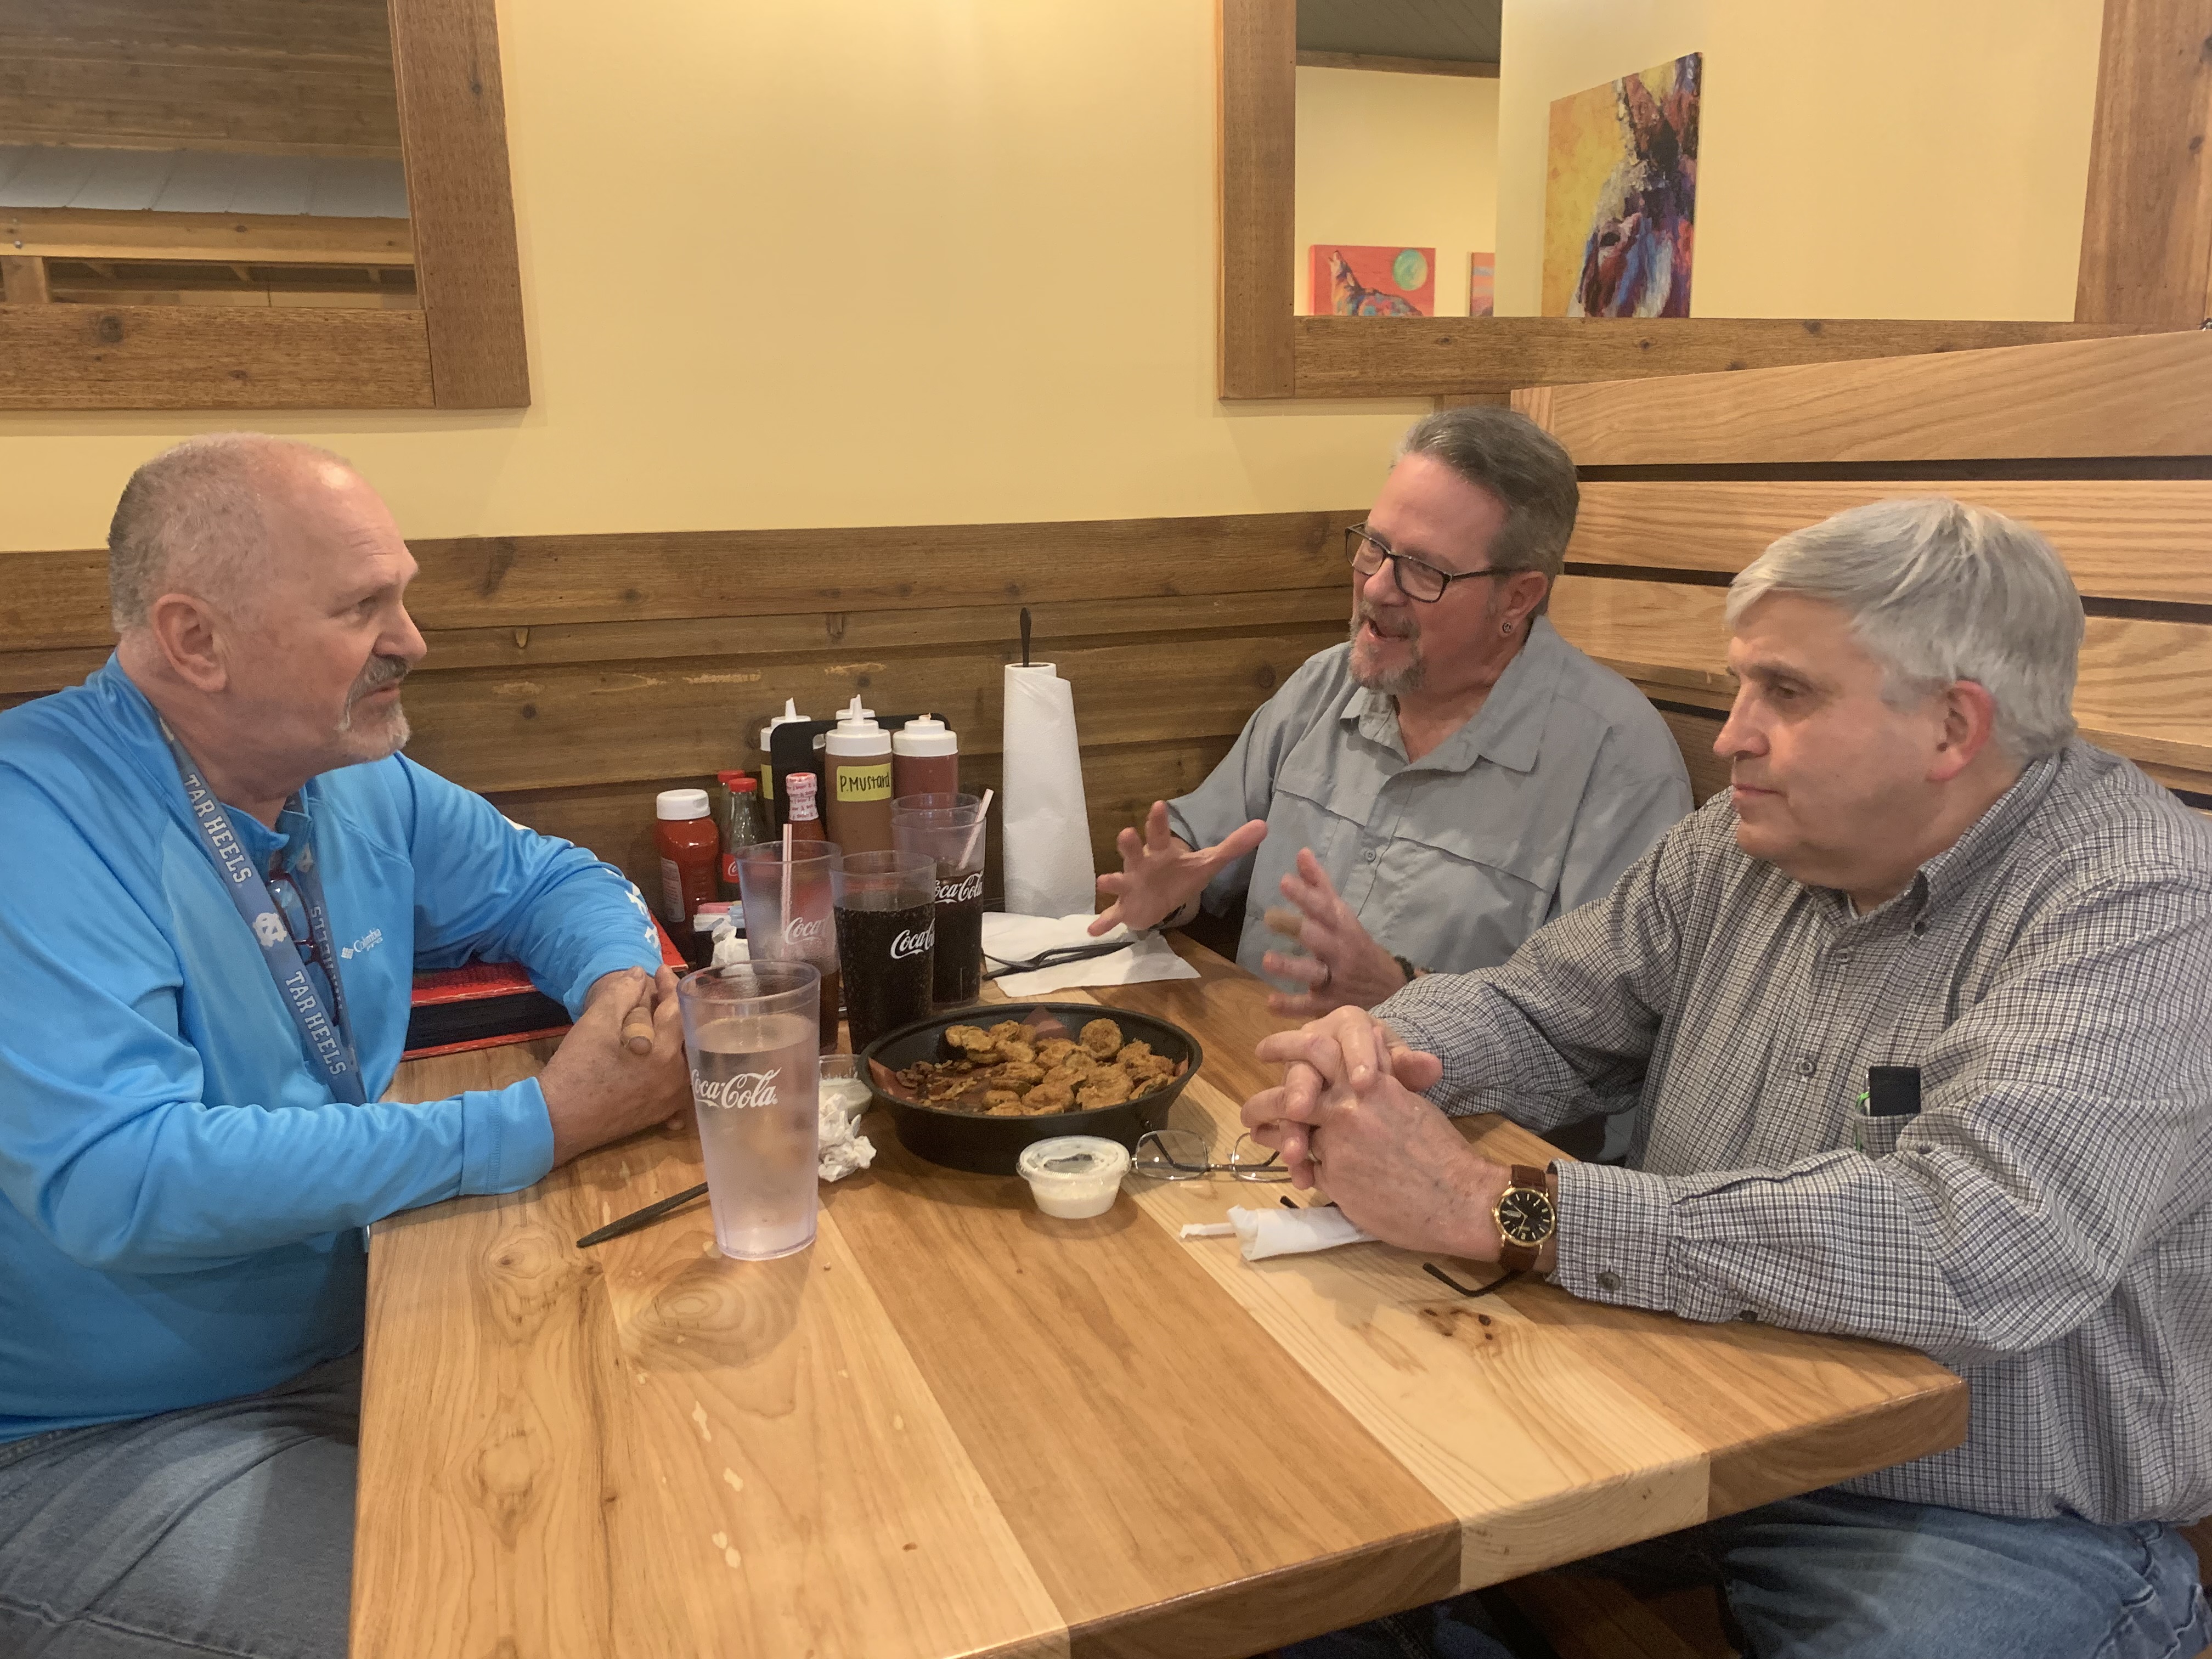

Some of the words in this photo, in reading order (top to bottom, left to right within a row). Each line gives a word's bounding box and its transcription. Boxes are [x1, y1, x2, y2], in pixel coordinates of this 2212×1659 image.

[184, 774, 216, 817] TAR
[204, 816, 252, 883] HEELS
[353, 928, 382, 952] Columbia
[285, 970, 317, 1013] TAR
[304, 1012, 347, 1075] HEELS
[692, 1067, 782, 1109] Coca-Cola
